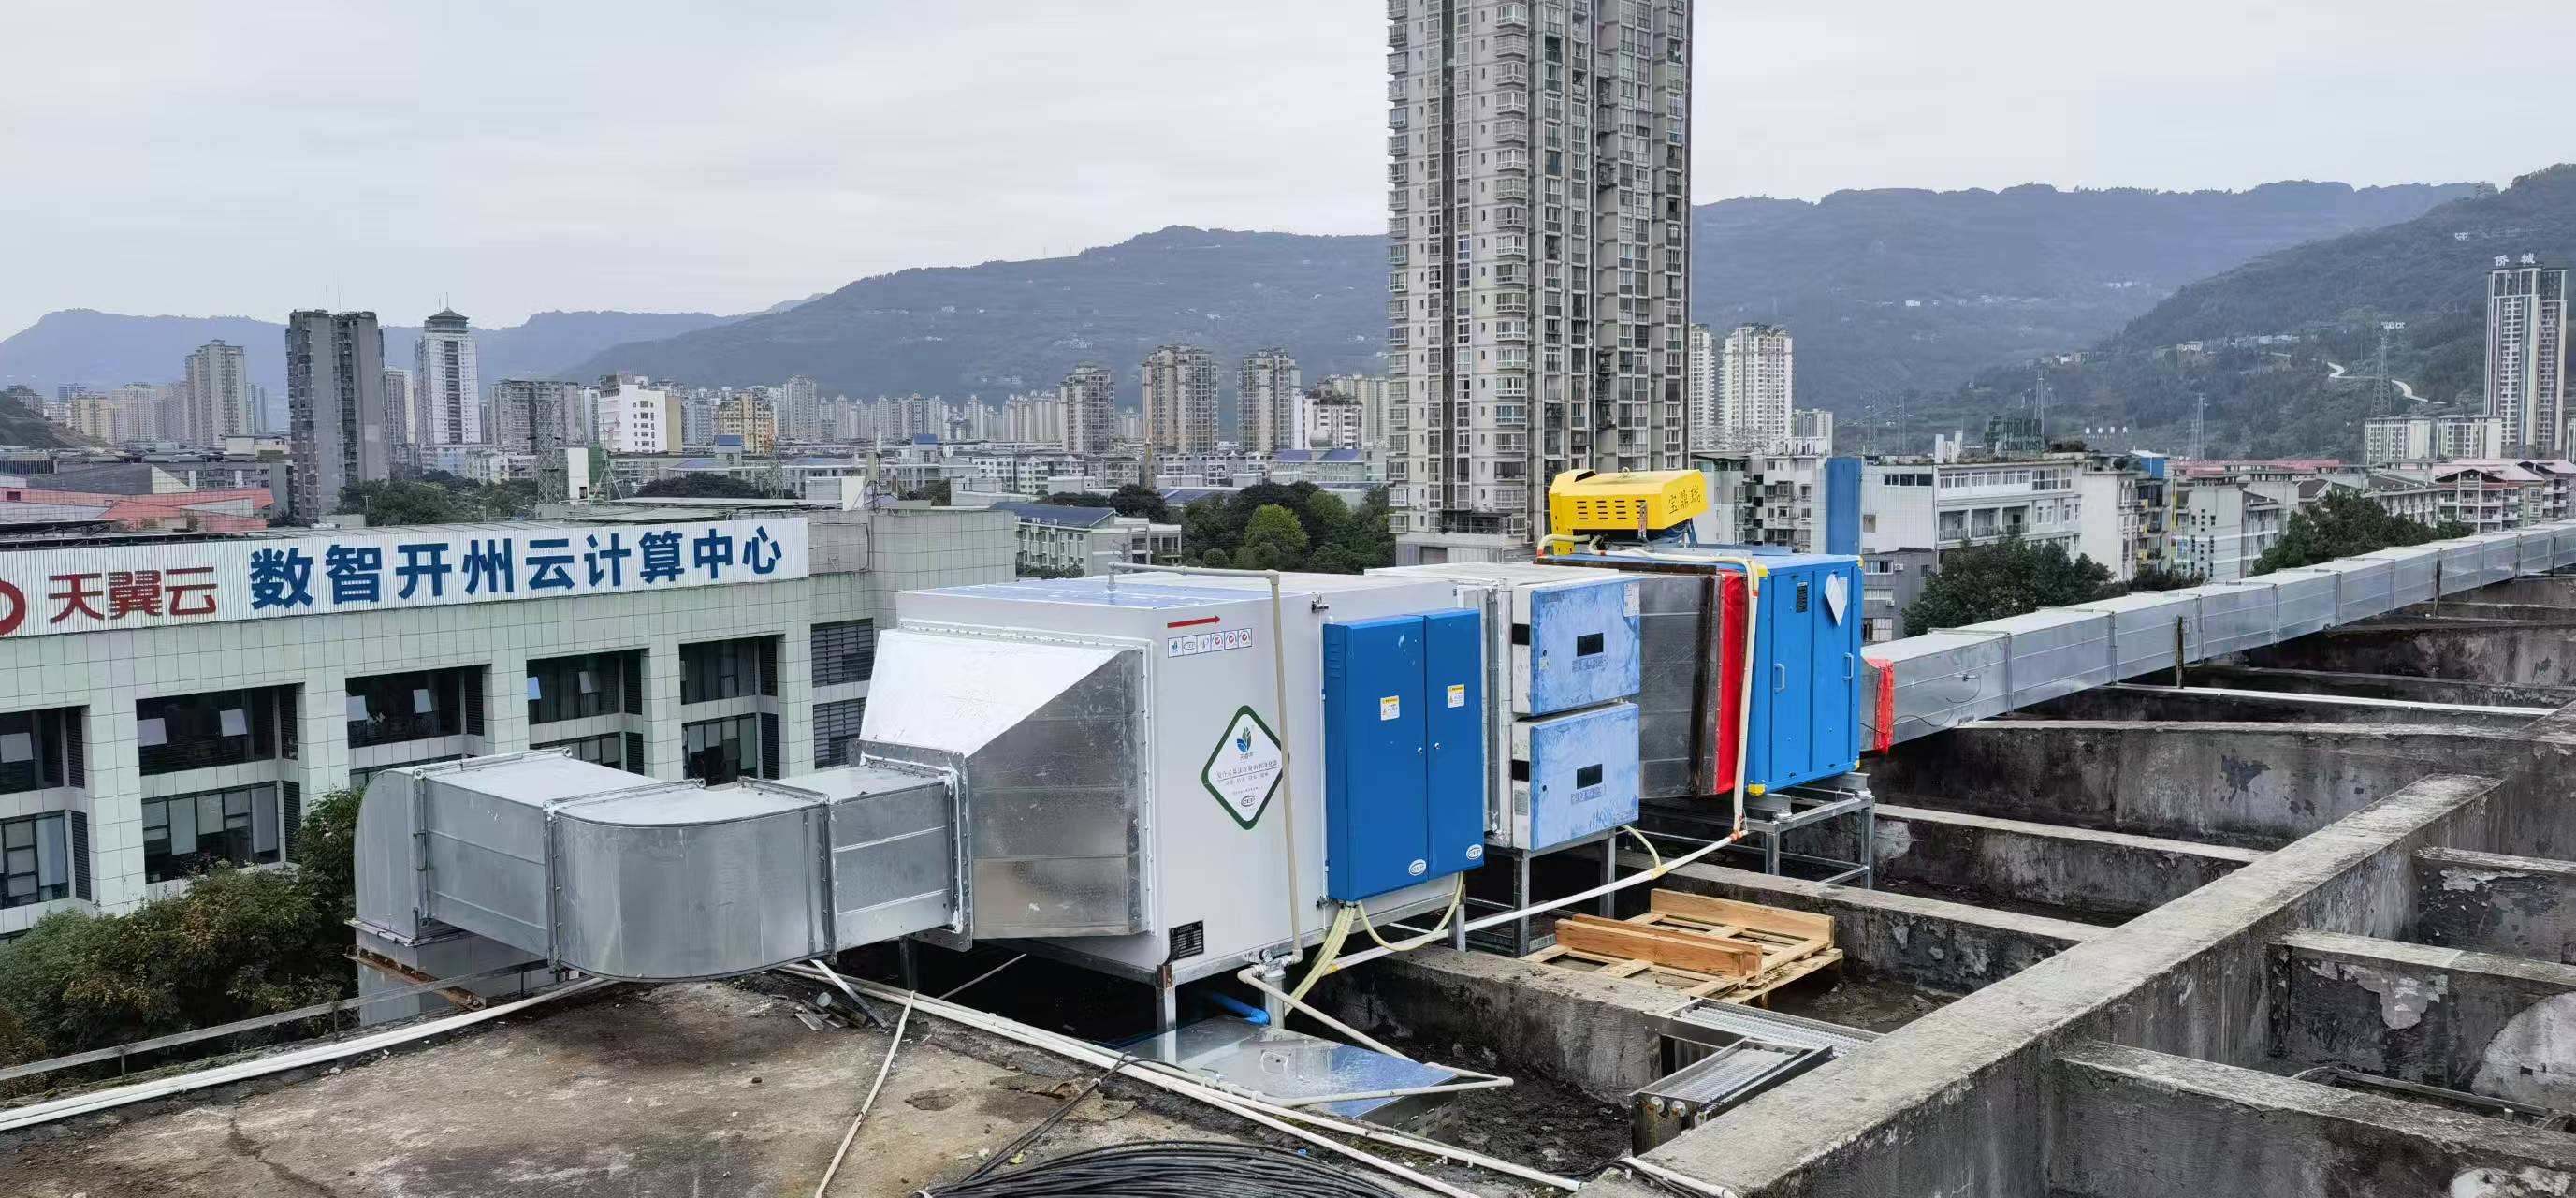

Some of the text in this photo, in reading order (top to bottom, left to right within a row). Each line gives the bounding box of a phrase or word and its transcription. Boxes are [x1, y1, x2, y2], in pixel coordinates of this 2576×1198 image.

[48, 525, 782, 624] 天翼云 数智开州云计算中心
